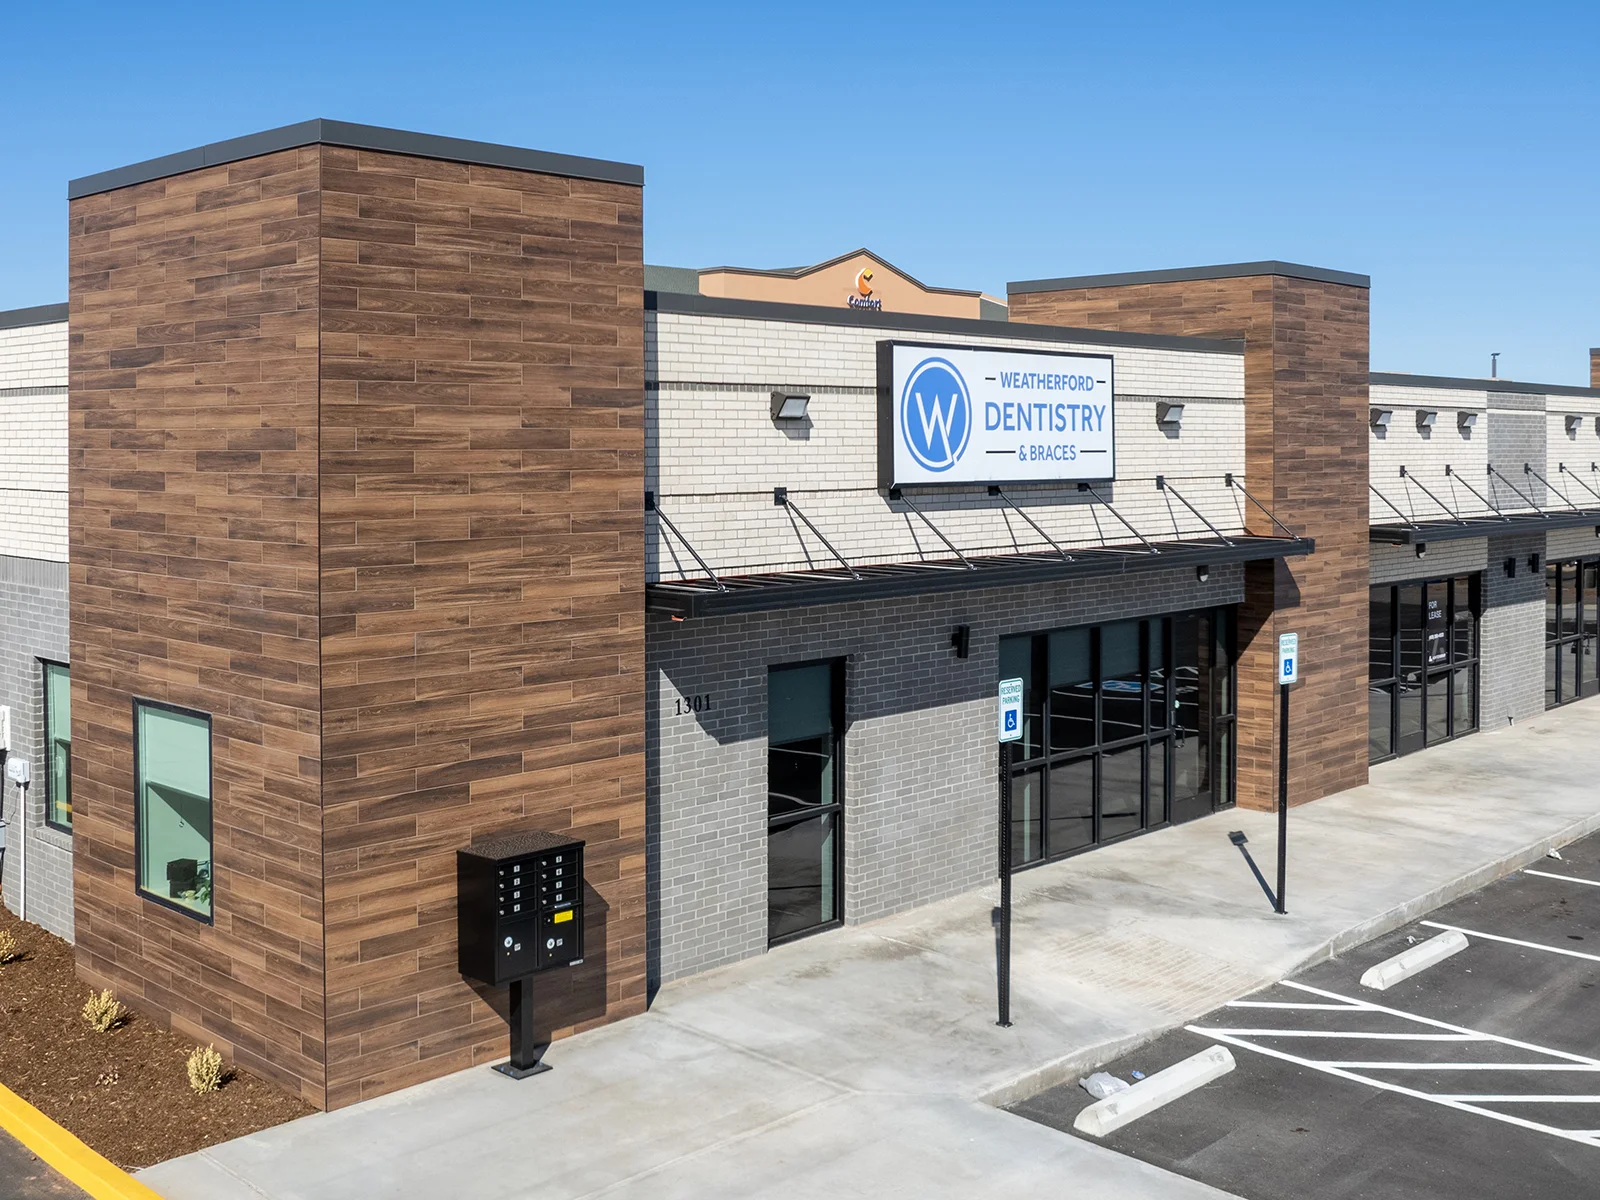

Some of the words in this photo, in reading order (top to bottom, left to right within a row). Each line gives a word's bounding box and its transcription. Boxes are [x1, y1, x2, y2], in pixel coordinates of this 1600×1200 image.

[1000, 371, 1094, 392] WEATHERFORD
[985, 401, 1106, 433] DENTISTRY
[1018, 446, 1028, 462] &
[1030, 445, 1077, 461] BRACES
[1428, 600, 1438, 609] FOR
[1428, 610, 1442, 620] LEASE
[1000, 684, 1021, 695] RESERVED
[675, 694, 711, 716] 1301
[1002, 694, 1020, 705] PARKING
